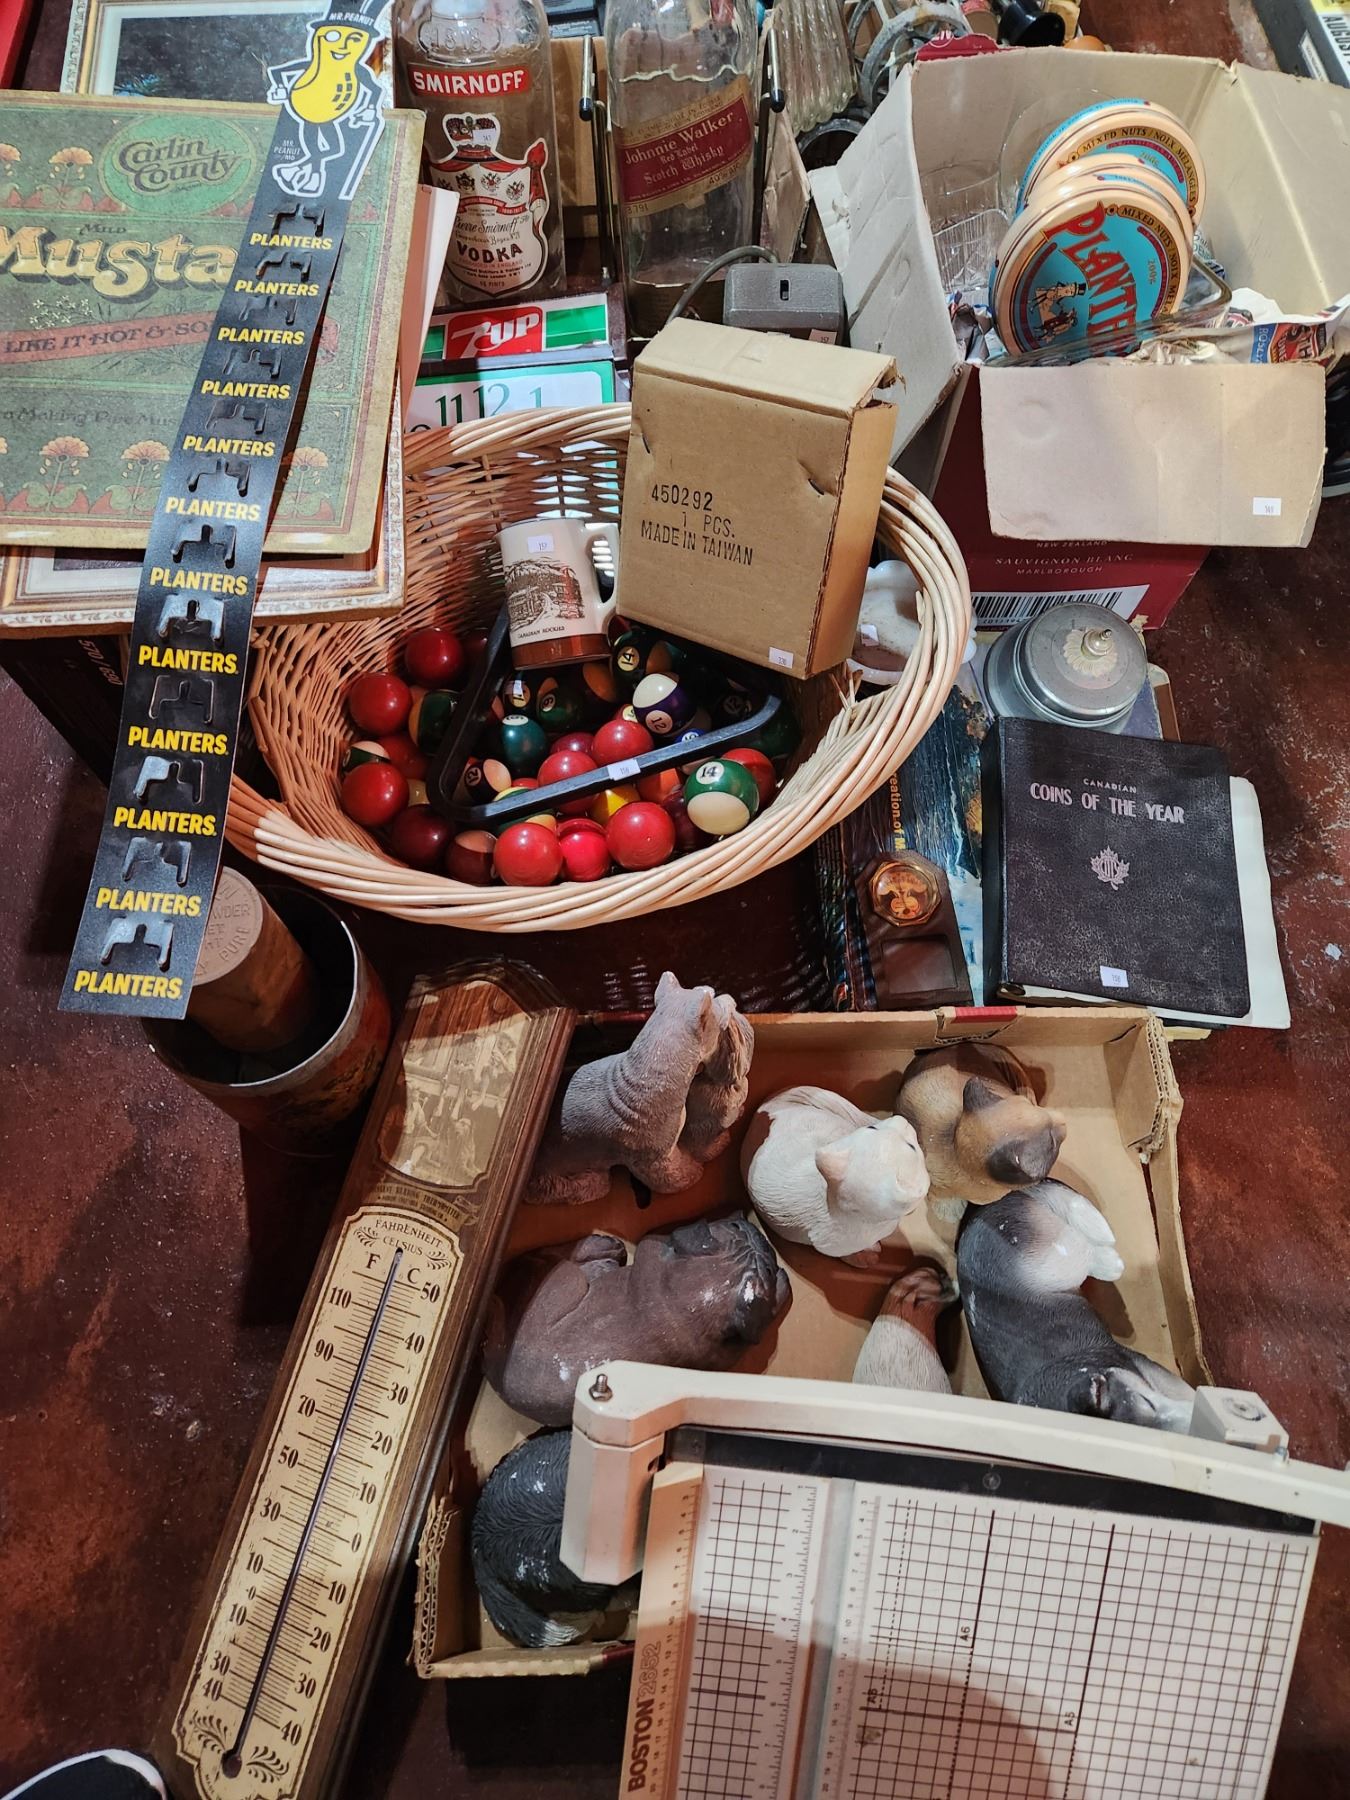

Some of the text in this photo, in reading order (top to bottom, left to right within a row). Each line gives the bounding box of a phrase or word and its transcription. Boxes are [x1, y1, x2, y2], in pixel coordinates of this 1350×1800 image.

[413, 70, 525, 95] SMIRNOFF
[625, 139, 677, 166] Johnnie
[678, 111, 734, 144] Walker
[1083, 131, 1117, 153] MIXED
[1121, 127, 1147, 137] NUTS
[1153, 131, 1175, 149] NOIX
[118, 137, 210, 174] Carlin
[643, 145, 724, 186] Scotch Whisky
[660, 153, 675, 164] Red
[134, 149, 243, 192] County
[249, 233, 333, 251] PLANTERS
[456, 241, 523, 263] VODKA
[1122, 207, 1154, 226] MIXED
[1155, 224, 1172, 249] NUTS
[1169, 253, 1178, 280] NOIX
[234, 279, 319, 298] PLANTERS
[63, 335, 86, 350] IT
[87, 329, 141, 346] HOT
[217, 327, 305, 346] PLANTERS
[201, 380, 290, 400] PLANTERS
[182, 435, 275, 457] PLANTERS
[165, 497, 261, 521] PLANTERS
[651, 484, 713, 512] 450292
[703, 514, 736, 539] PCS.
[641, 519, 753, 566] MADE IN TAIWAN
[1036, 539, 1108, 549] NEW ZEALAND
[995, 553, 1134, 566] SAUVIGNON BLANC
[1016, 566, 1103, 576] MARLBOROUGH
[149, 567, 249, 596] PLANTERS
[138, 644, 239, 675] PLANTERS
[621, 647, 634, 667] 14
[651, 716, 667, 731] 12
[127, 725, 229, 755] PLANTERS
[701, 765, 718, 779] 14
[1083, 778, 1137, 794] CANADIAN
[1030, 782, 1185, 824] COINS OF THE YEAR
[113, 807, 217, 836] PLANTERS
[95, 887, 202, 916] PLANTERS
[73, 971, 184, 1000] PLANTERS
[375, 1219, 444, 1248] FAHRENHEIT
[383, 1235, 423, 1256] CELSIUS
[366, 1253, 381, 1269] F
[407, 1268, 421, 1284] C
[328, 1286, 352, 1309] 110
[420, 1281, 441, 1304] 50
[314, 1339, 334, 1362] 90
[404, 1332, 425, 1354] 40
[297, 1394, 316, 1418] 70
[387, 1382, 409, 1406] 30
[370, 1430, 393, 1456] 20
[278, 1445, 299, 1469] 50
[359, 1481, 377, 1505] 10
[259, 1497, 281, 1522] 30
[246, 1551, 264, 1574] 10
[327, 1580, 347, 1605] 10
[229, 1603, 247, 1626] 10
[309, 1626, 332, 1652] 20
[959, 1625, 971, 1642] A6
[209, 1650, 231, 1676] 30
[202, 1676, 223, 1702] 40
[294, 1672, 317, 1699] 30
[627, 1640, 662, 1793] BOSTON 2652
[1064, 1711, 1076, 1727] A5
[281, 1719, 303, 1746] 40
